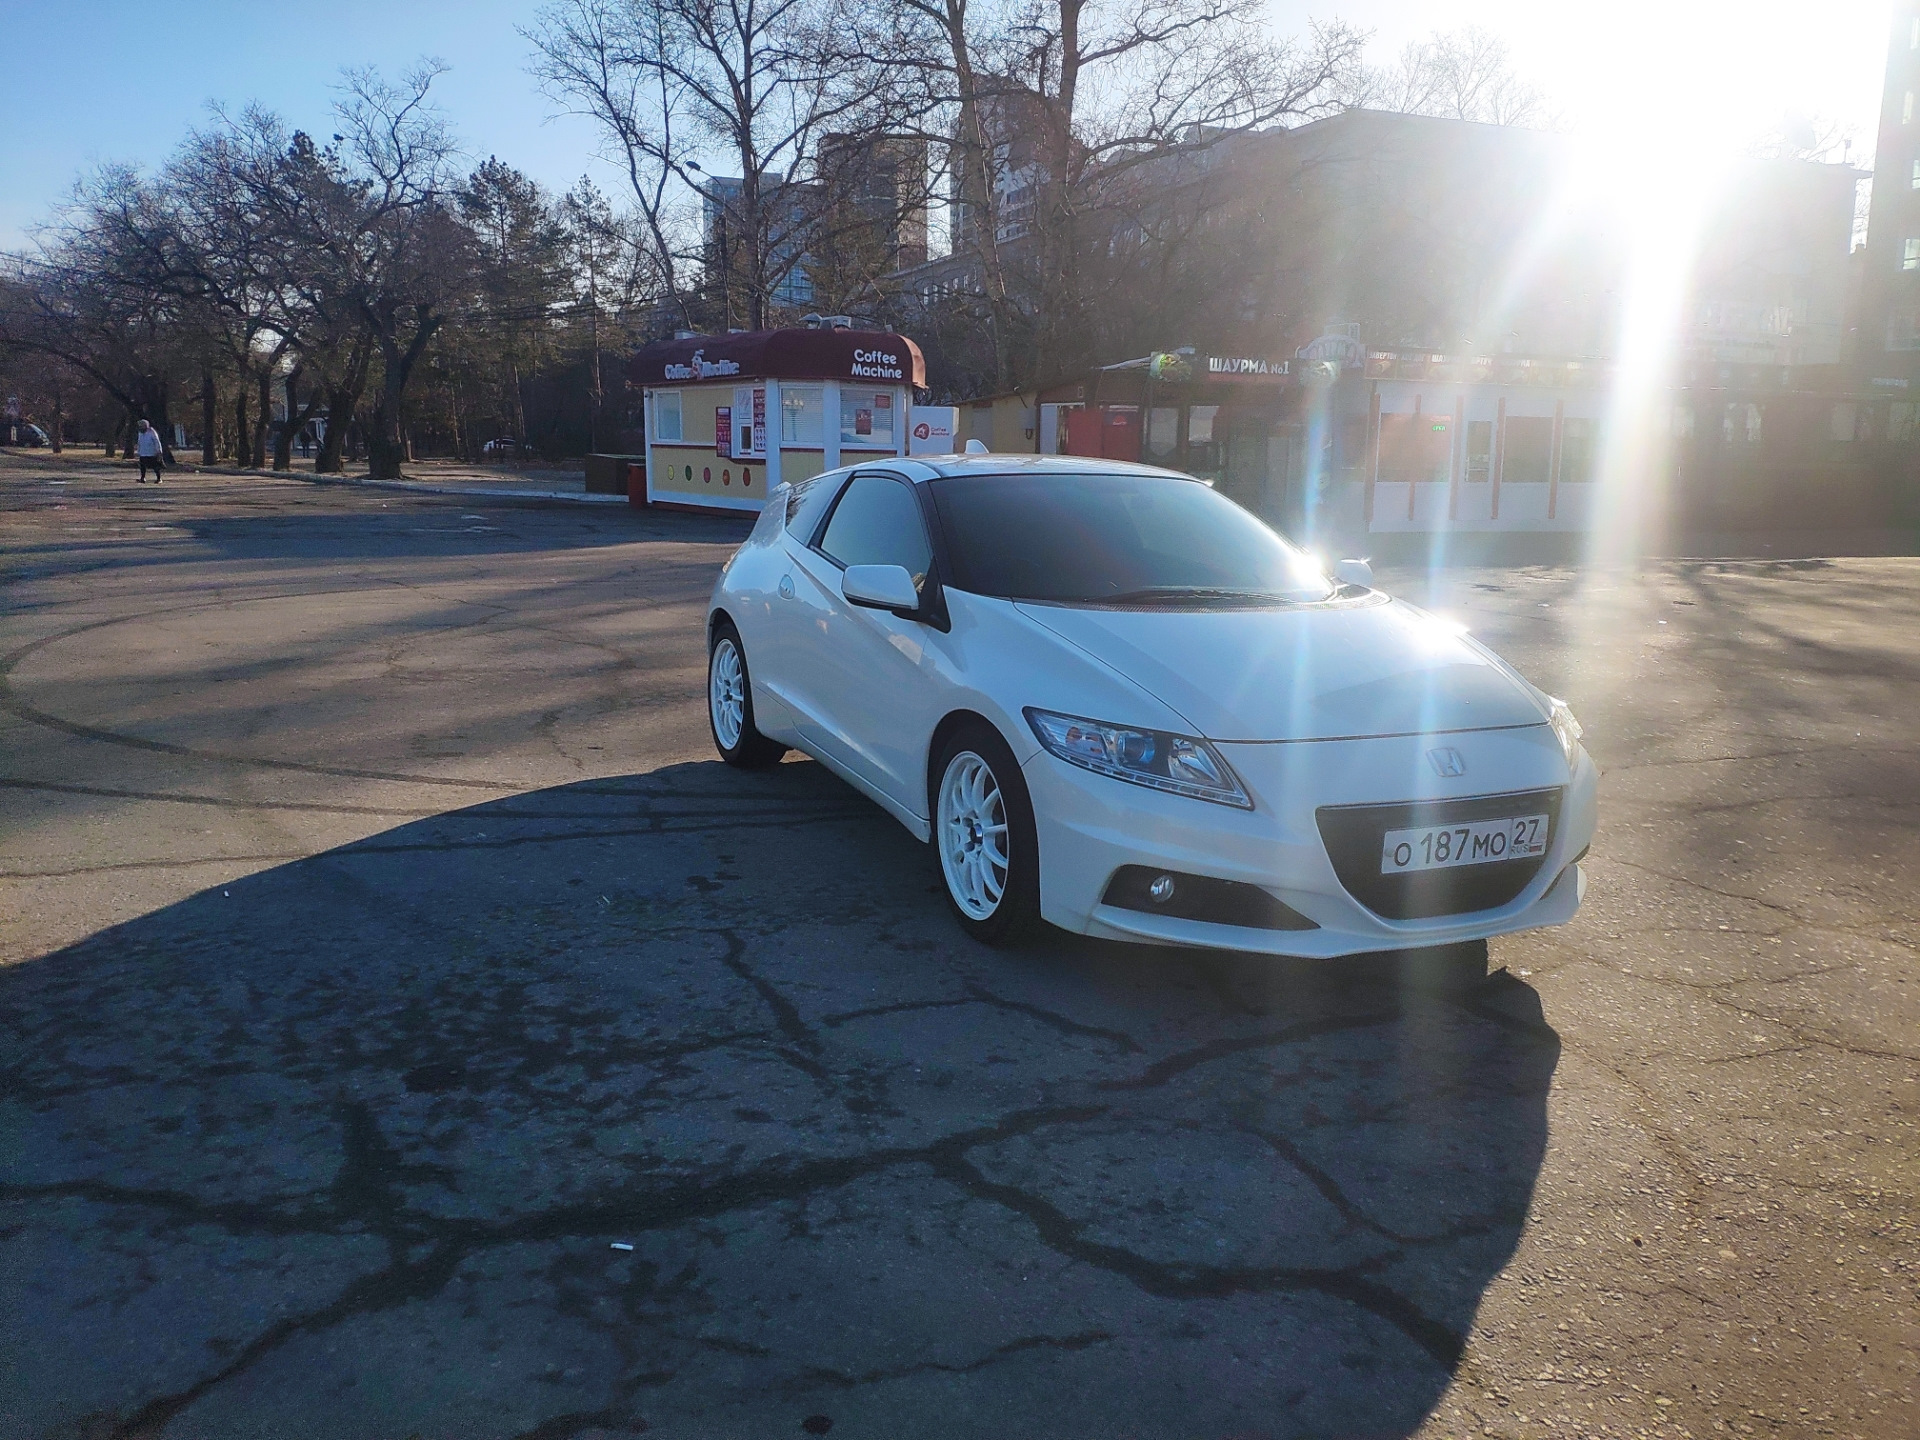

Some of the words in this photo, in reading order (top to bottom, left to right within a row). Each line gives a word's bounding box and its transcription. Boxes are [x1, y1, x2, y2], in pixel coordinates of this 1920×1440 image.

[853, 348, 897, 365] Coffee
[851, 362, 903, 379] Machine
[1209, 357, 1268, 374] ШАУРМА
[1513, 818, 1540, 846] 27
[1510, 844, 1529, 855] RUS
